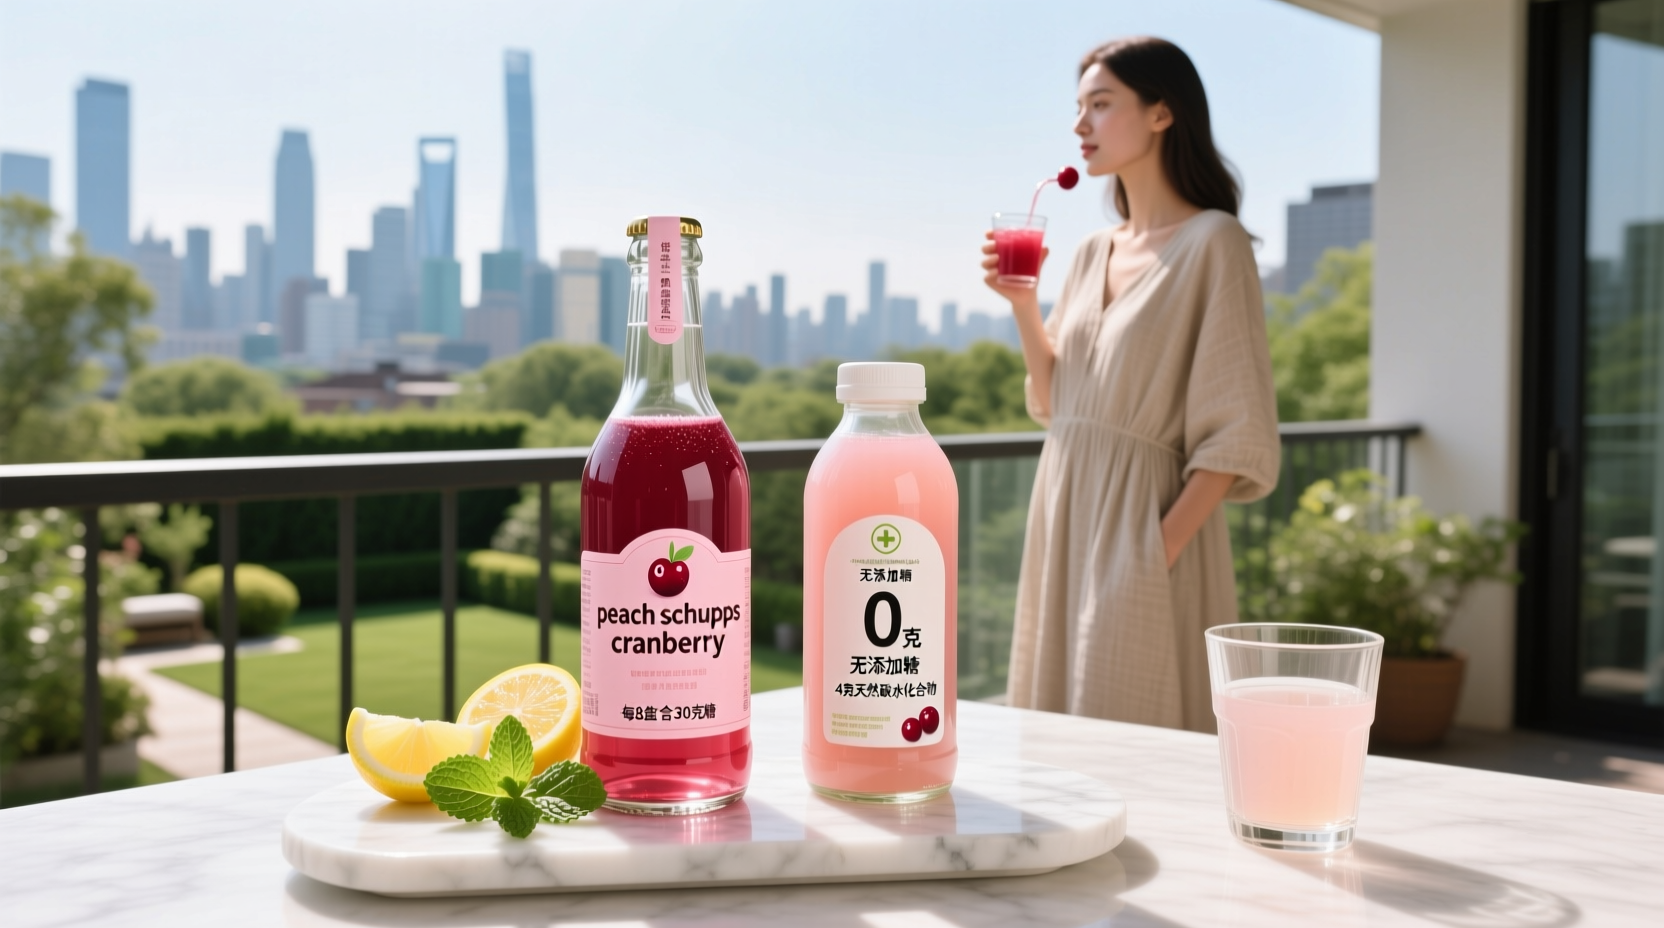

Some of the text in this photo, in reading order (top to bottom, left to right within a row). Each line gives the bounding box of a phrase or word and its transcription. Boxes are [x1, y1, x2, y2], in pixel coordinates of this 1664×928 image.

[597, 602, 741, 629] peach schupps
[611, 631, 726, 658] cranberry
[849, 655, 920, 675] 无添加糖
